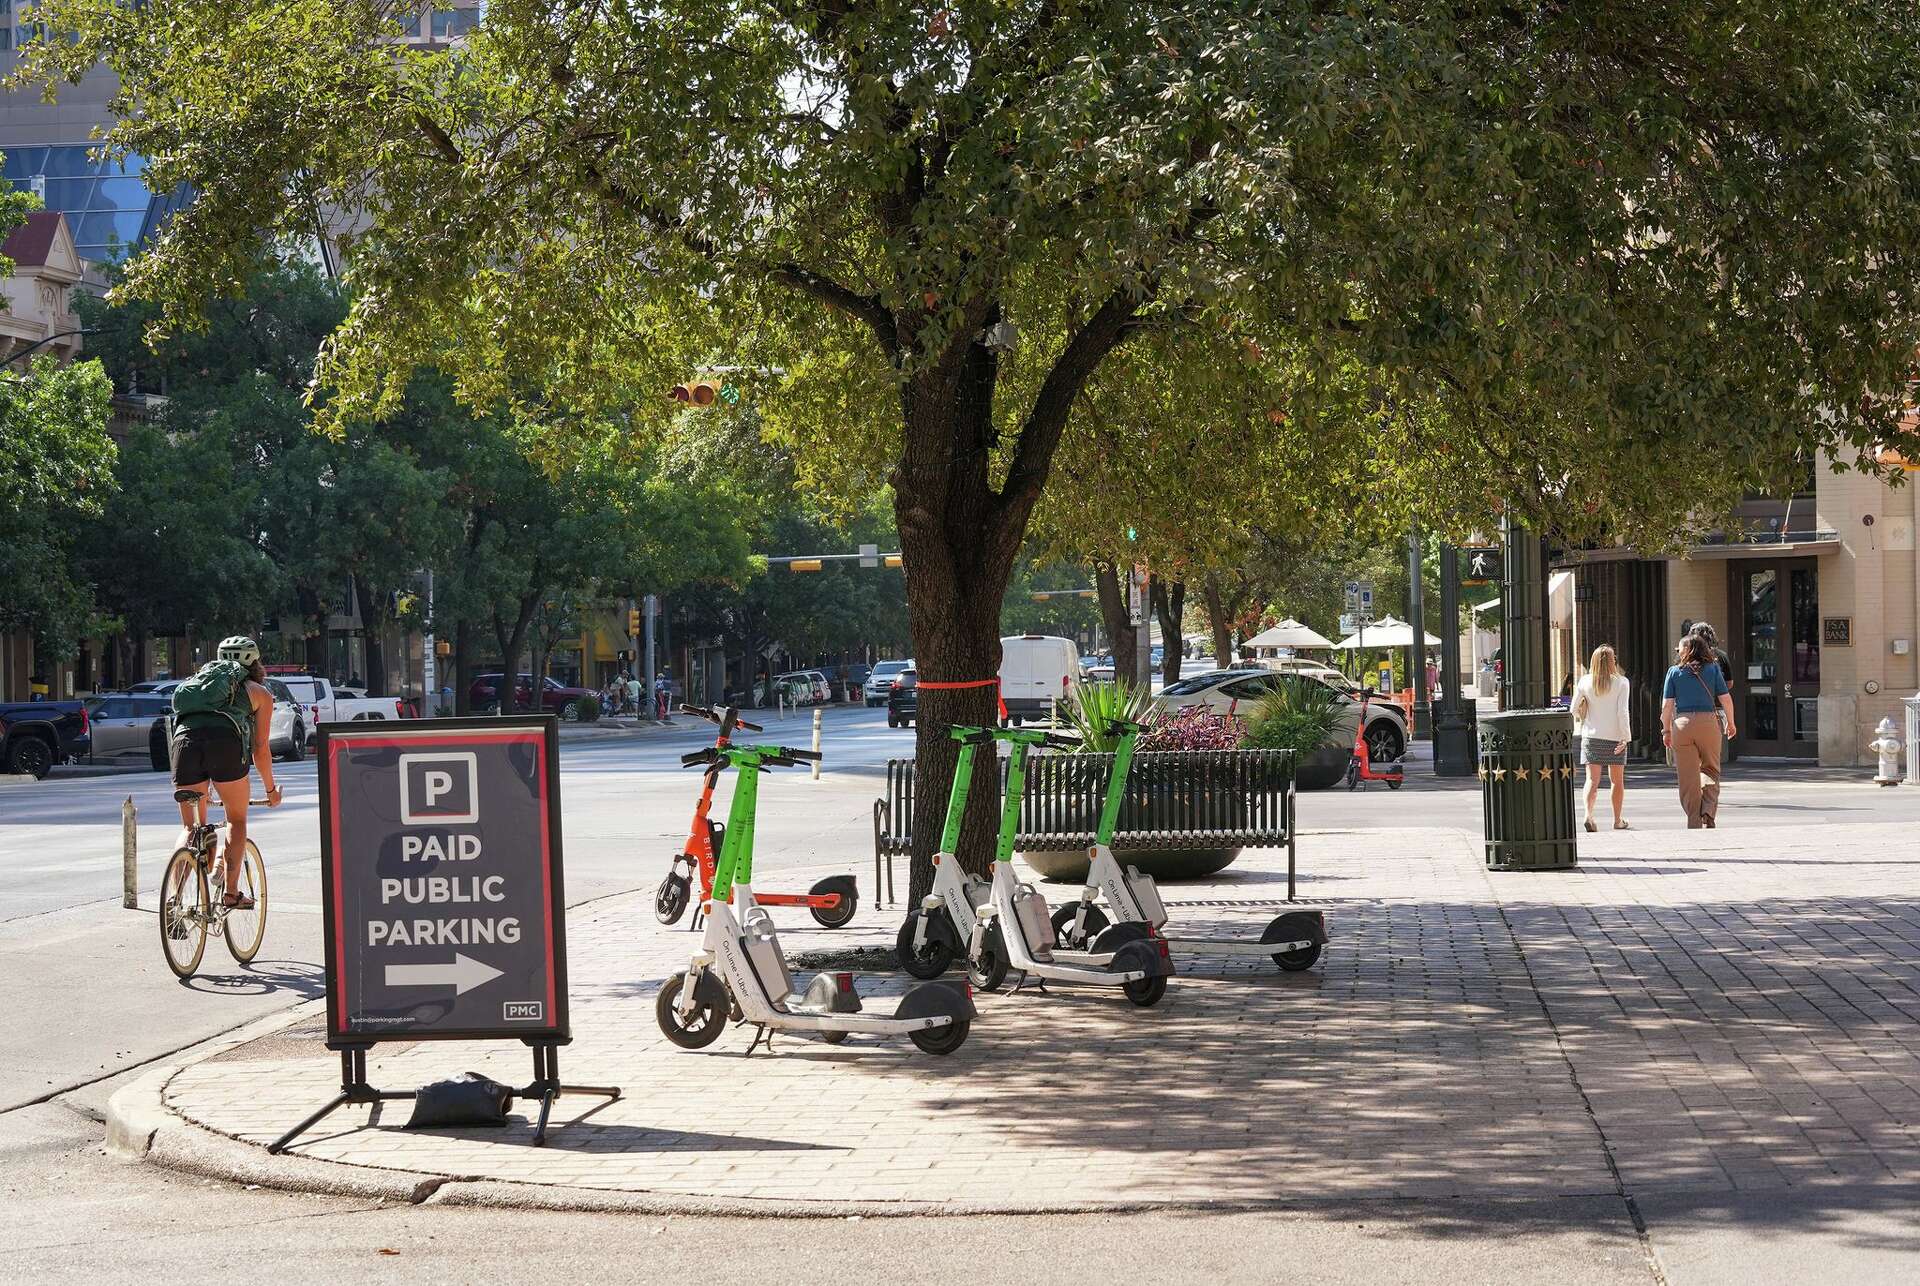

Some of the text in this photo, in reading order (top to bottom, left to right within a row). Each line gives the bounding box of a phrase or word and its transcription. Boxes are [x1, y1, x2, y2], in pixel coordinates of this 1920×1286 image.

[1825, 631, 1848, 640] BANK
[425, 771, 453, 807] P
[402, 834, 482, 862] PAID
[703, 836, 714, 869] BIRD
[381, 875, 506, 905] PUBLIC
[367, 917, 521, 946] PARKING
[737, 977, 749, 998] Uber
[509, 1005, 537, 1016] PMC
